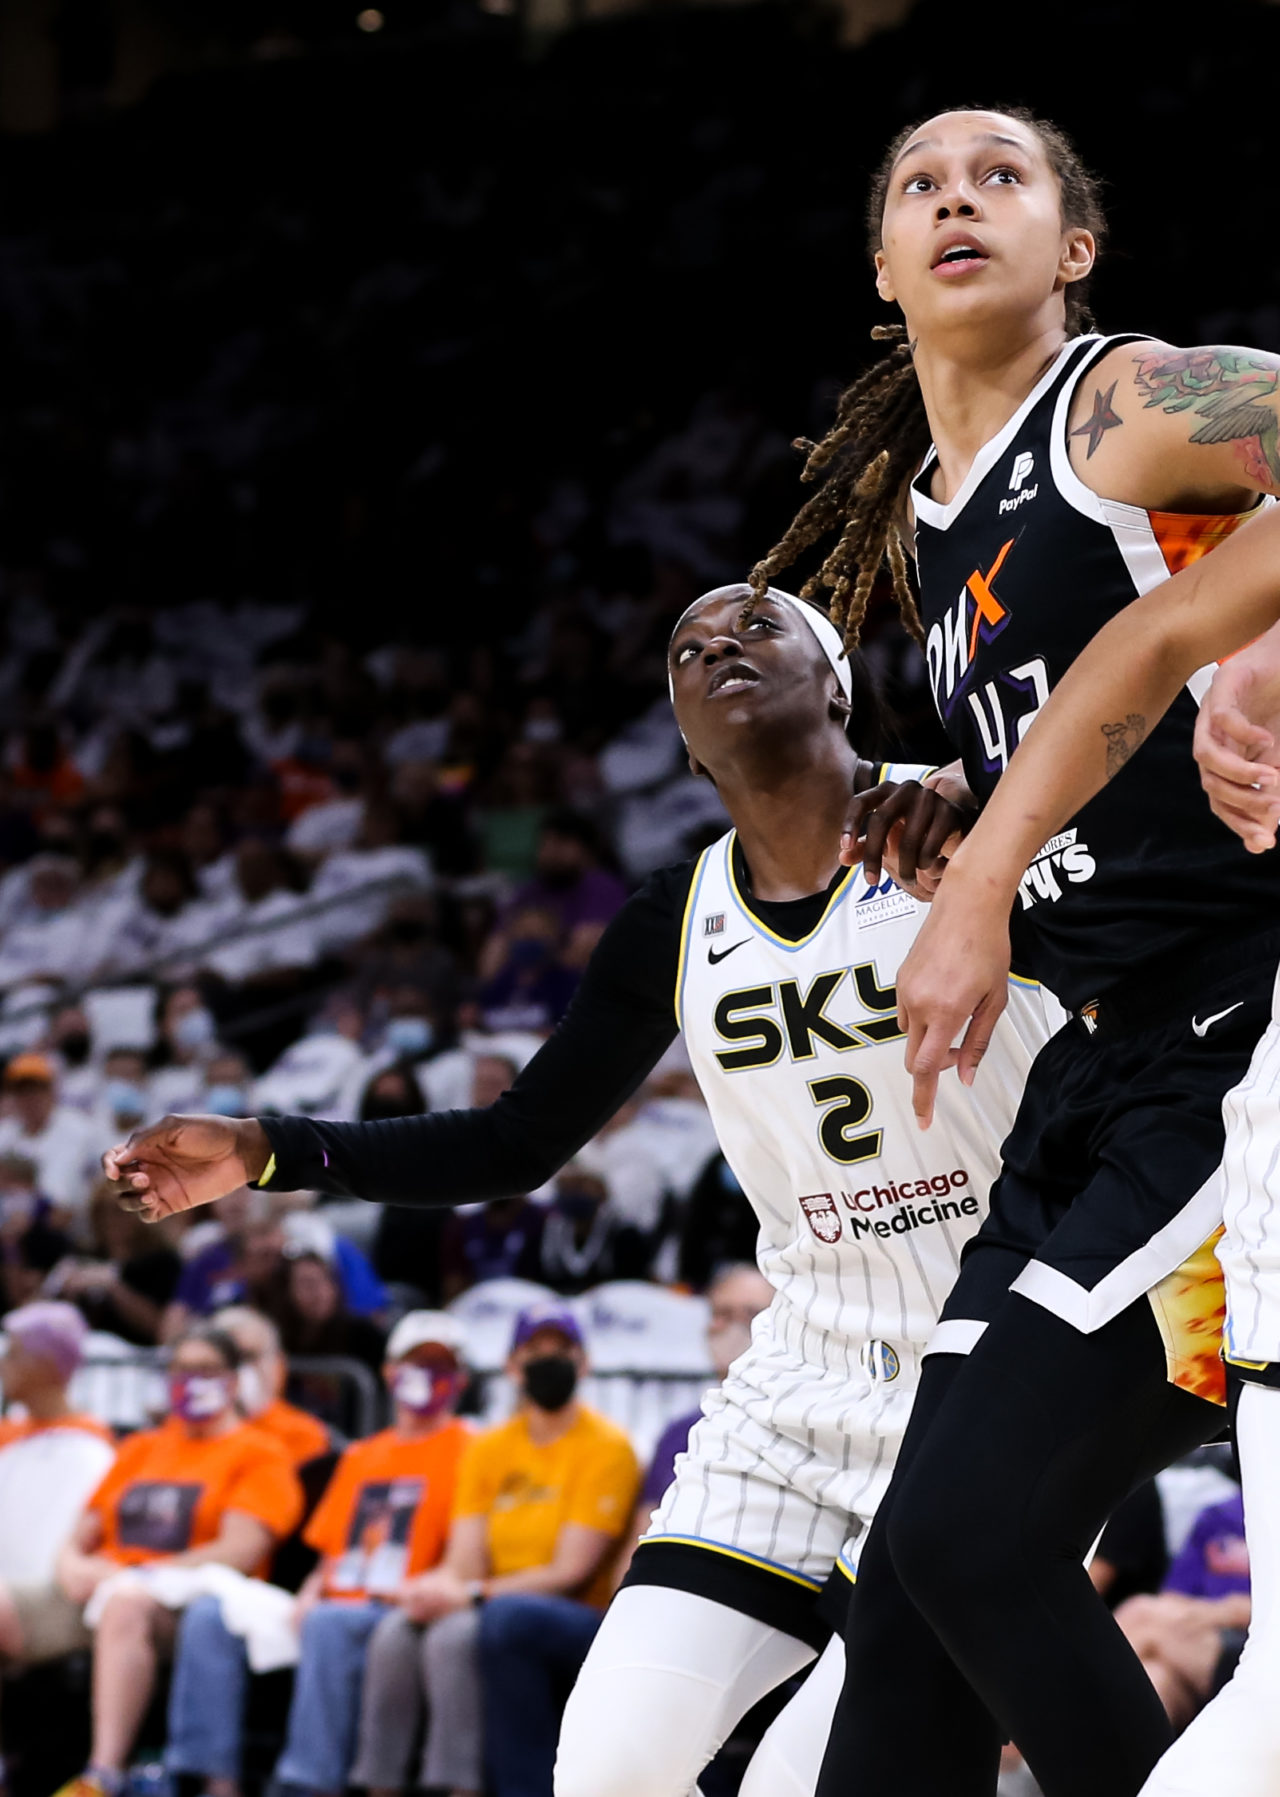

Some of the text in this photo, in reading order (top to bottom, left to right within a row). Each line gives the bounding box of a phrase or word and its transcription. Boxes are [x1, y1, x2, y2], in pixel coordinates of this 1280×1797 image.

[998, 482, 1039, 515] PayPal
[1017, 843, 1096, 911] ry's
[855, 894, 914, 918] MAGELLAN
[806, 1073, 884, 1166] 2
[850, 1196, 979, 1241] Medicine
